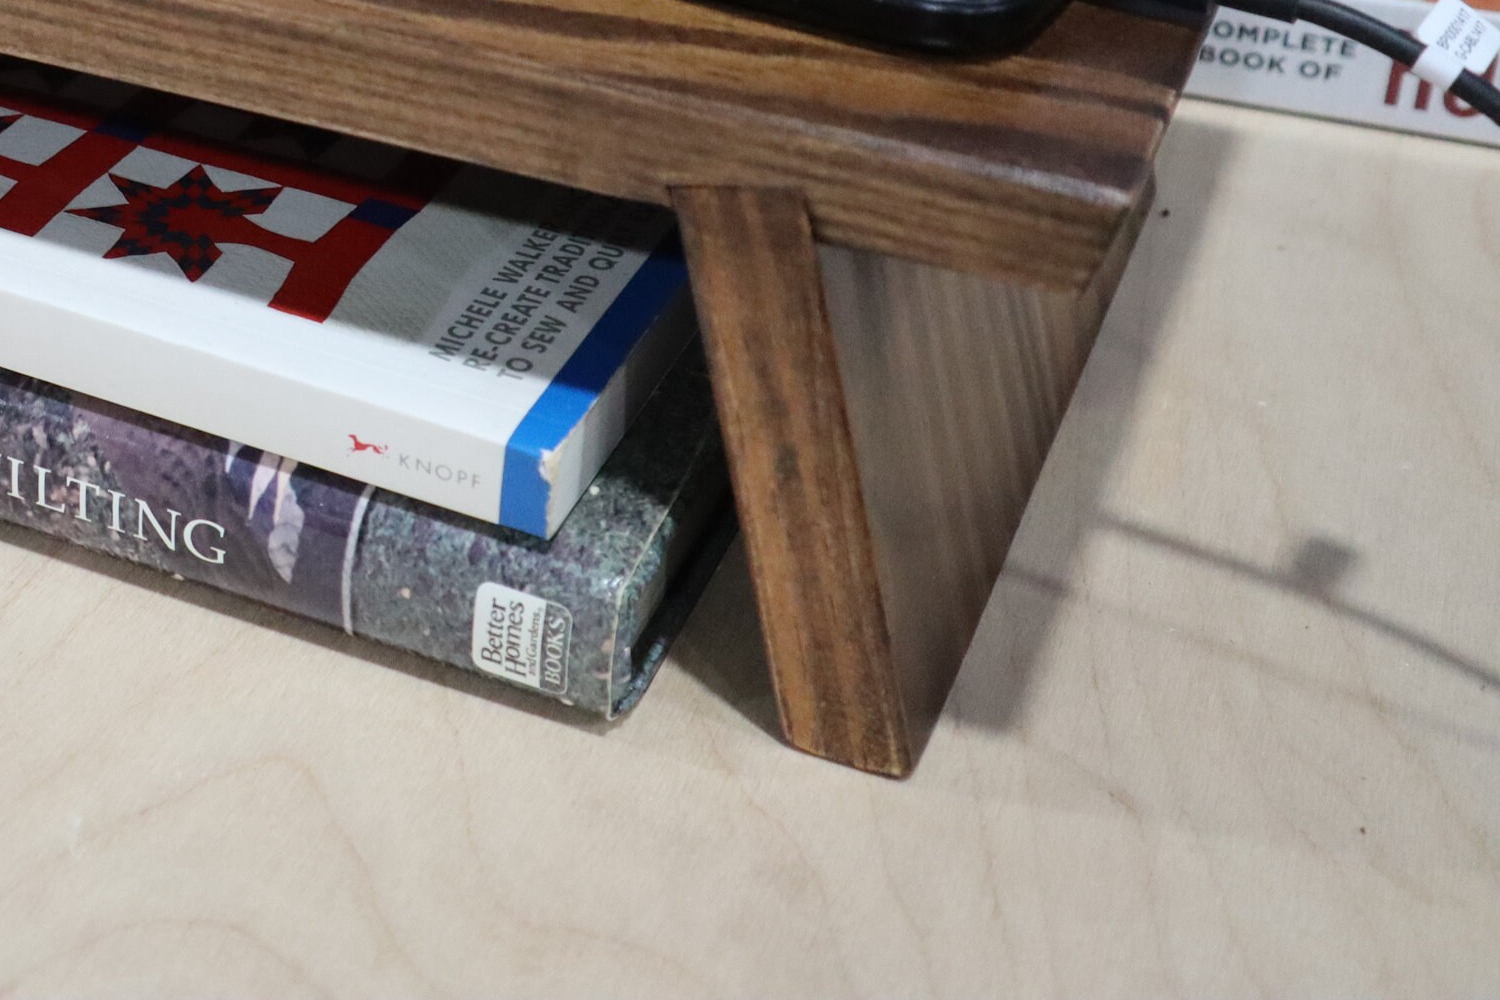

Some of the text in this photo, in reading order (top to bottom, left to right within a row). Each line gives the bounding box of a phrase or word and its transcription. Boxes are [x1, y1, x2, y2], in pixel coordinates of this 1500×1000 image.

[1199, 45, 1342, 82] BOOK OF
[1212, 20, 1357, 58] OMPLETE
[429, 221, 564, 362] MICHELE WALKER
[463, 229, 593, 372] RE-CREATE TRADI
[496, 357, 533, 381] TO
[522, 315, 567, 354] SEW
[557, 274, 600, 314] AND
[399, 453, 482, 489] KNOPF
[481, 597, 506, 666] Better
[505, 600, 527, 678] Homes
[545, 615, 566, 685] BOOKS
